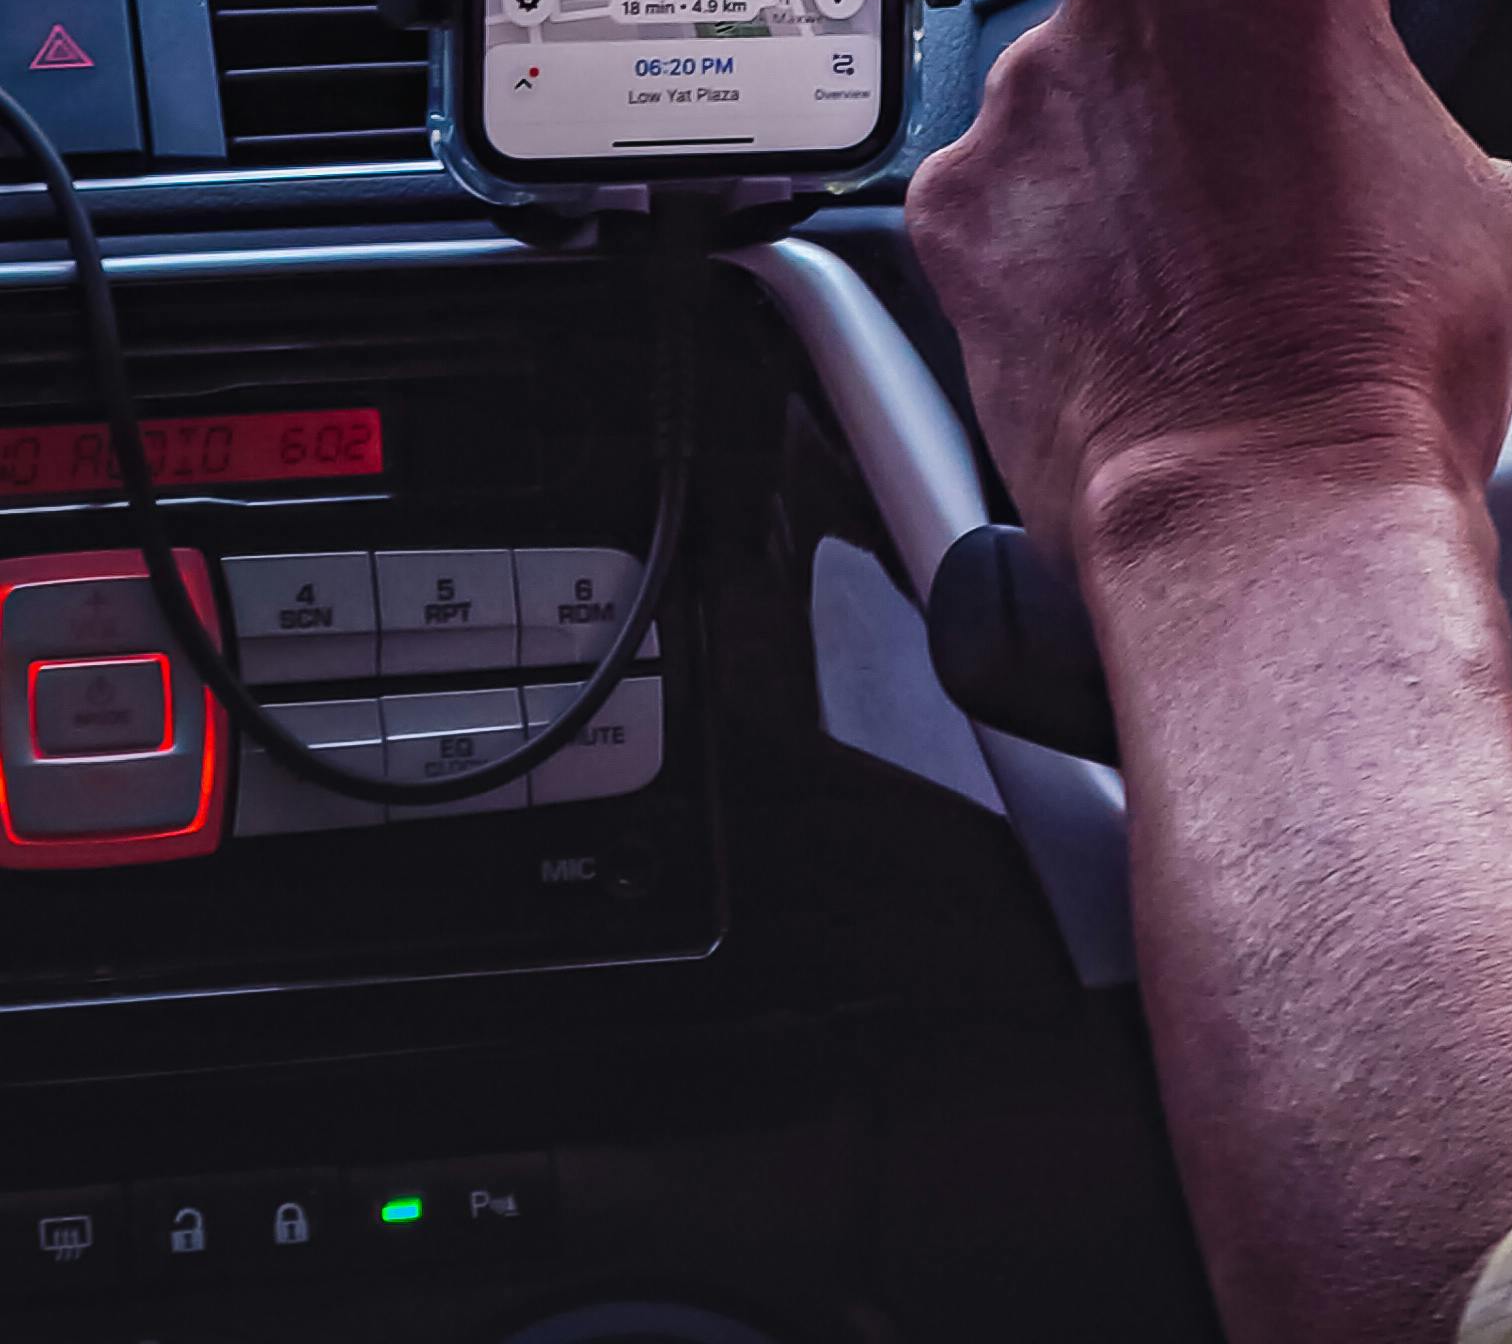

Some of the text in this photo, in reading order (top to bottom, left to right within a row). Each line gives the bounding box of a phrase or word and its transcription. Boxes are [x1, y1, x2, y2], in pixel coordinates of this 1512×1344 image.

[622, 0, 640, 16] 18
[645, 0, 675, 14] min
[634, 56, 734, 77] 06:20 PM
[627, 87, 740, 104] Low Yat Plaza
[814, 89, 871, 101] Overview
[295, 584, 315, 604] 4
[437, 578, 455, 601] 5
[575, 579, 593, 601] 6
[279, 607, 333, 629] SCN
[424, 602, 472, 625] RPT
[558, 602, 615, 625] RDM
[440, 738, 474, 760] EQ
[541, 857, 597, 883] MIC
